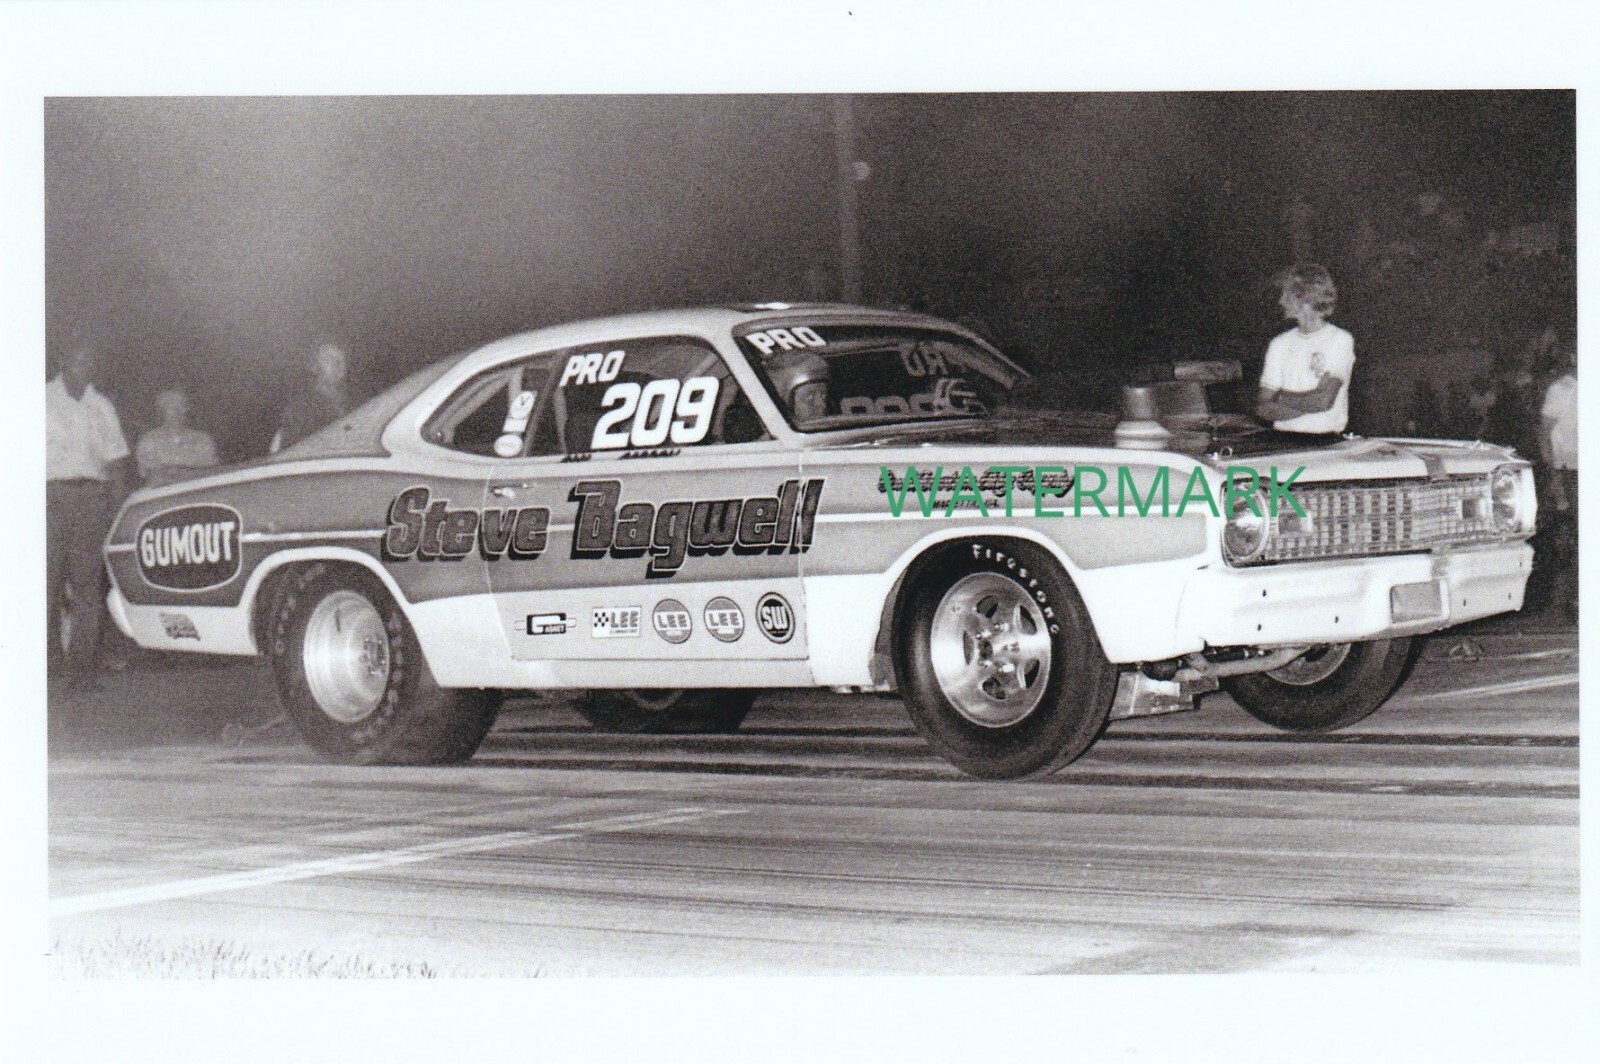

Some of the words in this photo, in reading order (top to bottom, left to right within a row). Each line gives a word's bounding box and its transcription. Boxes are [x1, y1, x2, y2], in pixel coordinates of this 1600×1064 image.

[746, 326, 827, 354] PRO
[559, 350, 626, 387] PRO
[591, 376, 720, 450] 209
[383, 484, 551, 562] Steve
[568, 476, 827, 579] Bagwell
[141, 521, 235, 568] GUMOUT
[610, 610, 639, 628] LEE
[657, 613, 687, 629] LEE
[708, 612, 740, 626] LEE
[762, 606, 788, 630] SW
